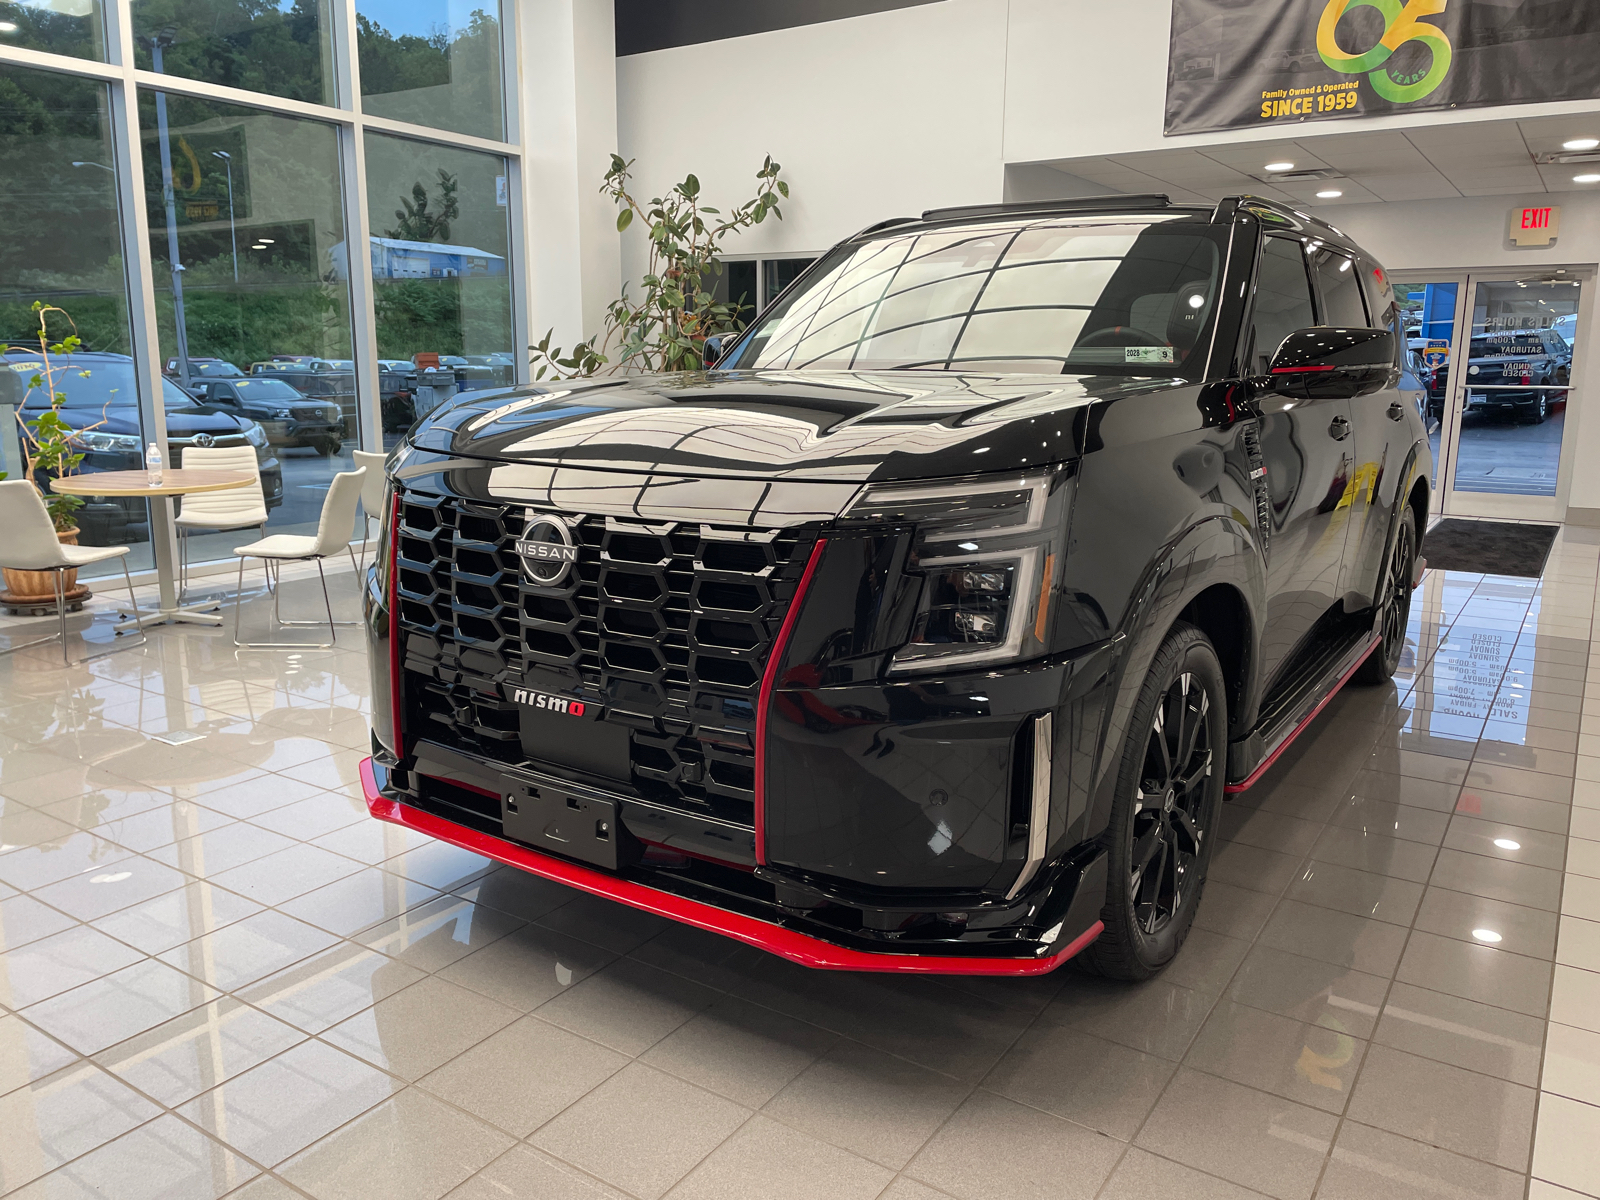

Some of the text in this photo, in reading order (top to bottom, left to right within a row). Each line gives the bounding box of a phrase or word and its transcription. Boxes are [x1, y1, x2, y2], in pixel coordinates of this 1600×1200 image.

[1390, 68, 1426, 84] YEARS
[1261, 80, 1359, 99] Family Owned & Operated
[1260, 91, 1358, 118] SINCE 1959
[1521, 207, 1552, 229] EXIT
[515, 542, 575, 560] NISSAN
